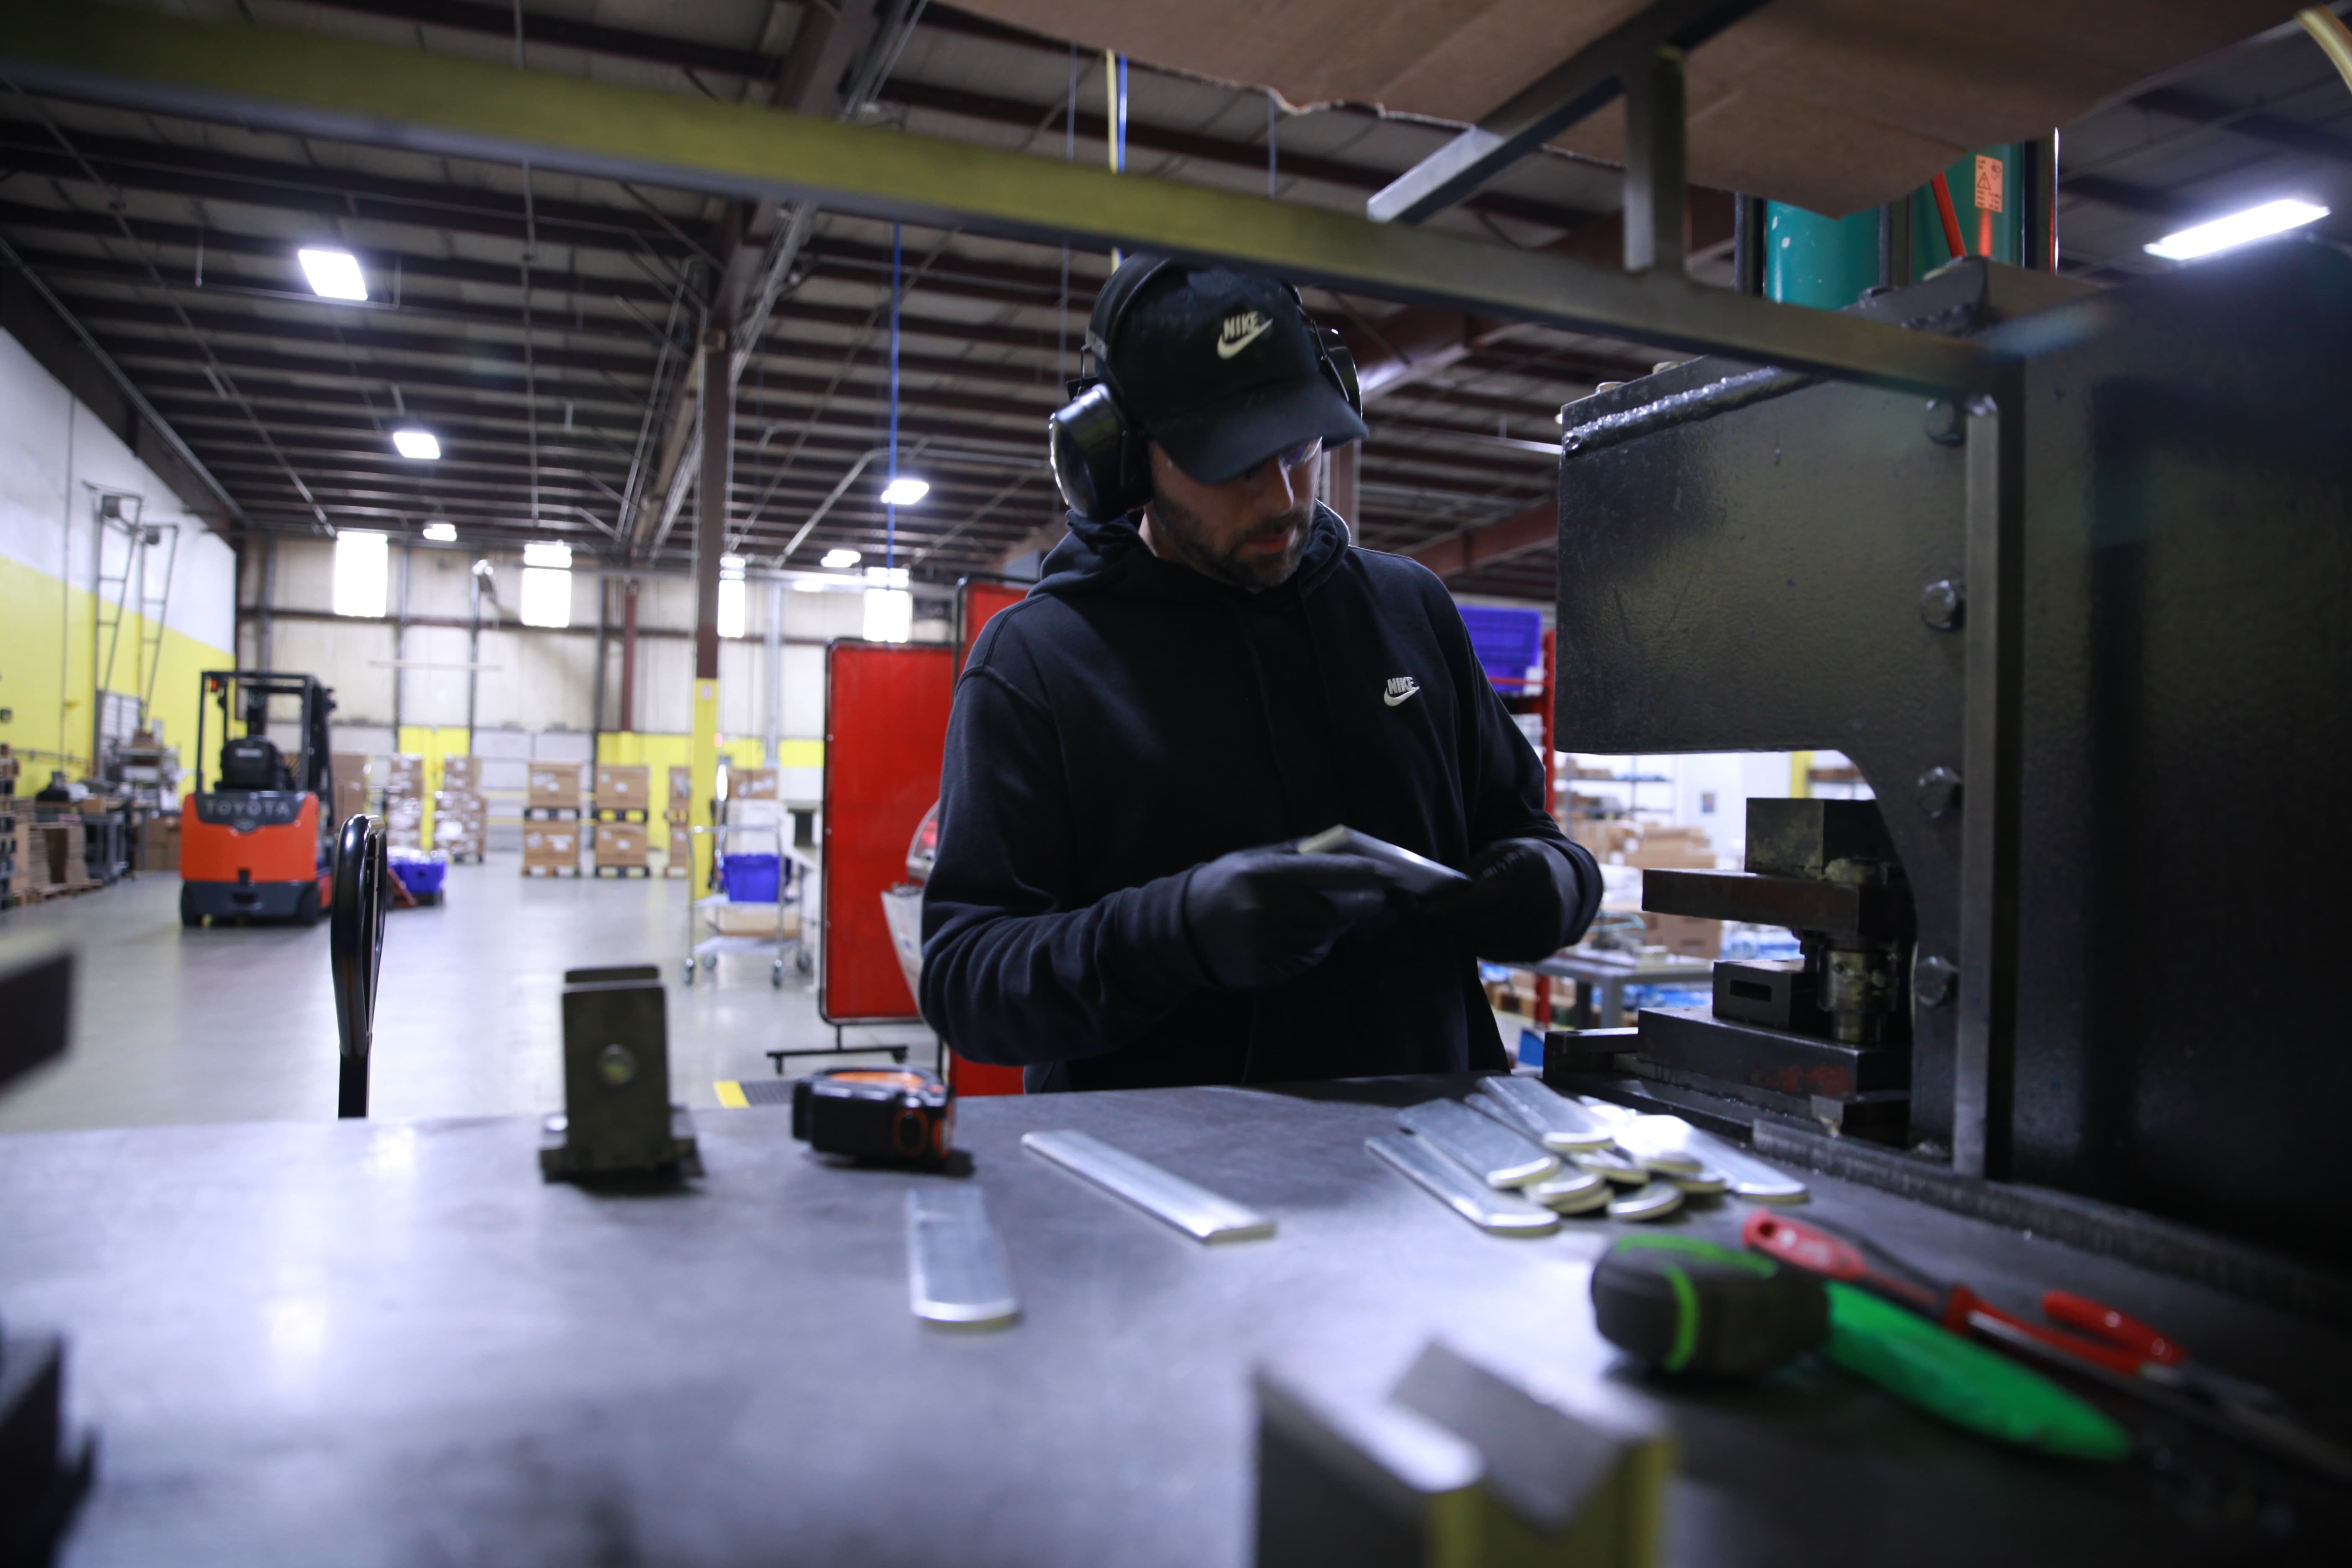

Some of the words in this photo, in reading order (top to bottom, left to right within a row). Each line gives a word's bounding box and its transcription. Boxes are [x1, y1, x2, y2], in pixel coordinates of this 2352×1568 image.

[1223, 311, 1259, 340] NIKE
[1387, 676, 1414, 695] NIKE
[205, 799, 291, 816] TOYOTA
